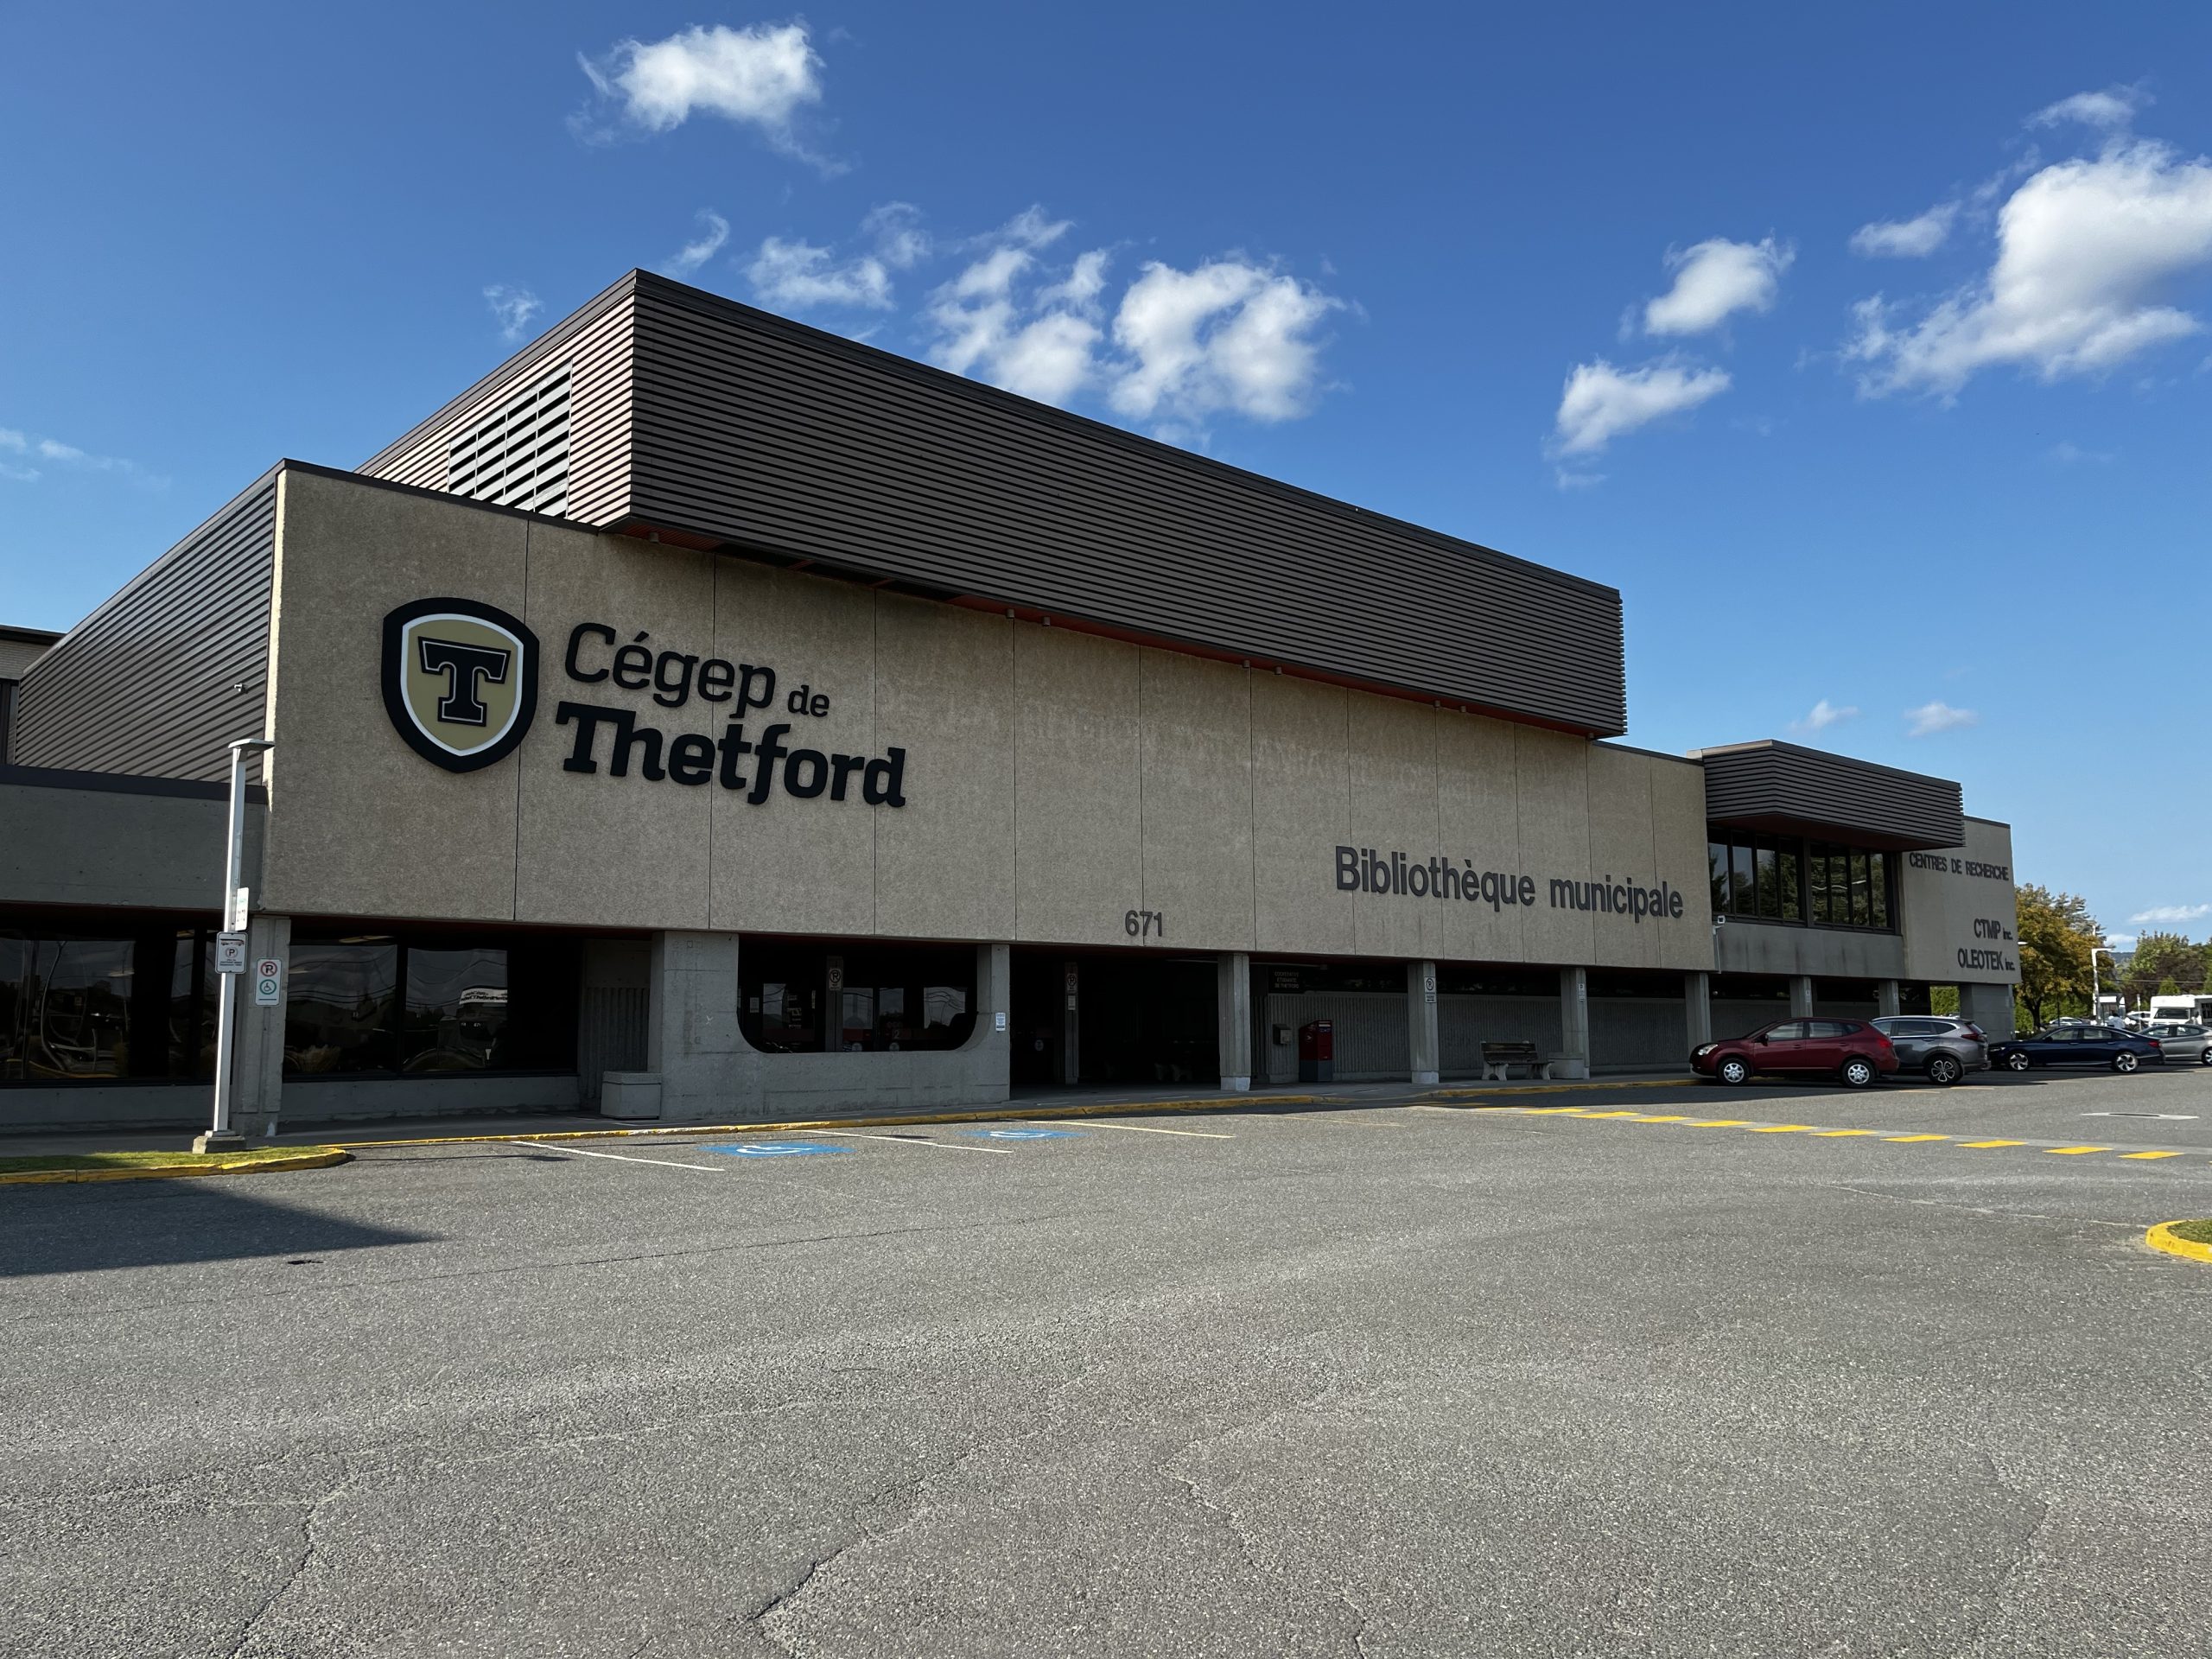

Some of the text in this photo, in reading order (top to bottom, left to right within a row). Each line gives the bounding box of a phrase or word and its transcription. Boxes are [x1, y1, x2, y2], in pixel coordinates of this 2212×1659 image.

[564, 622, 830, 720] Cégep de
[556, 701, 906, 808] Thetford
[1909, 852, 2010, 881] CENTRES DE RECHERCHE
[1335, 845, 1684, 924] Bibliothèque municipale
[1124, 910, 1164, 938] 671
[1974, 918, 2013, 941] CTMP inc.
[1957, 947, 2016, 971] OLEOTEK inc.
